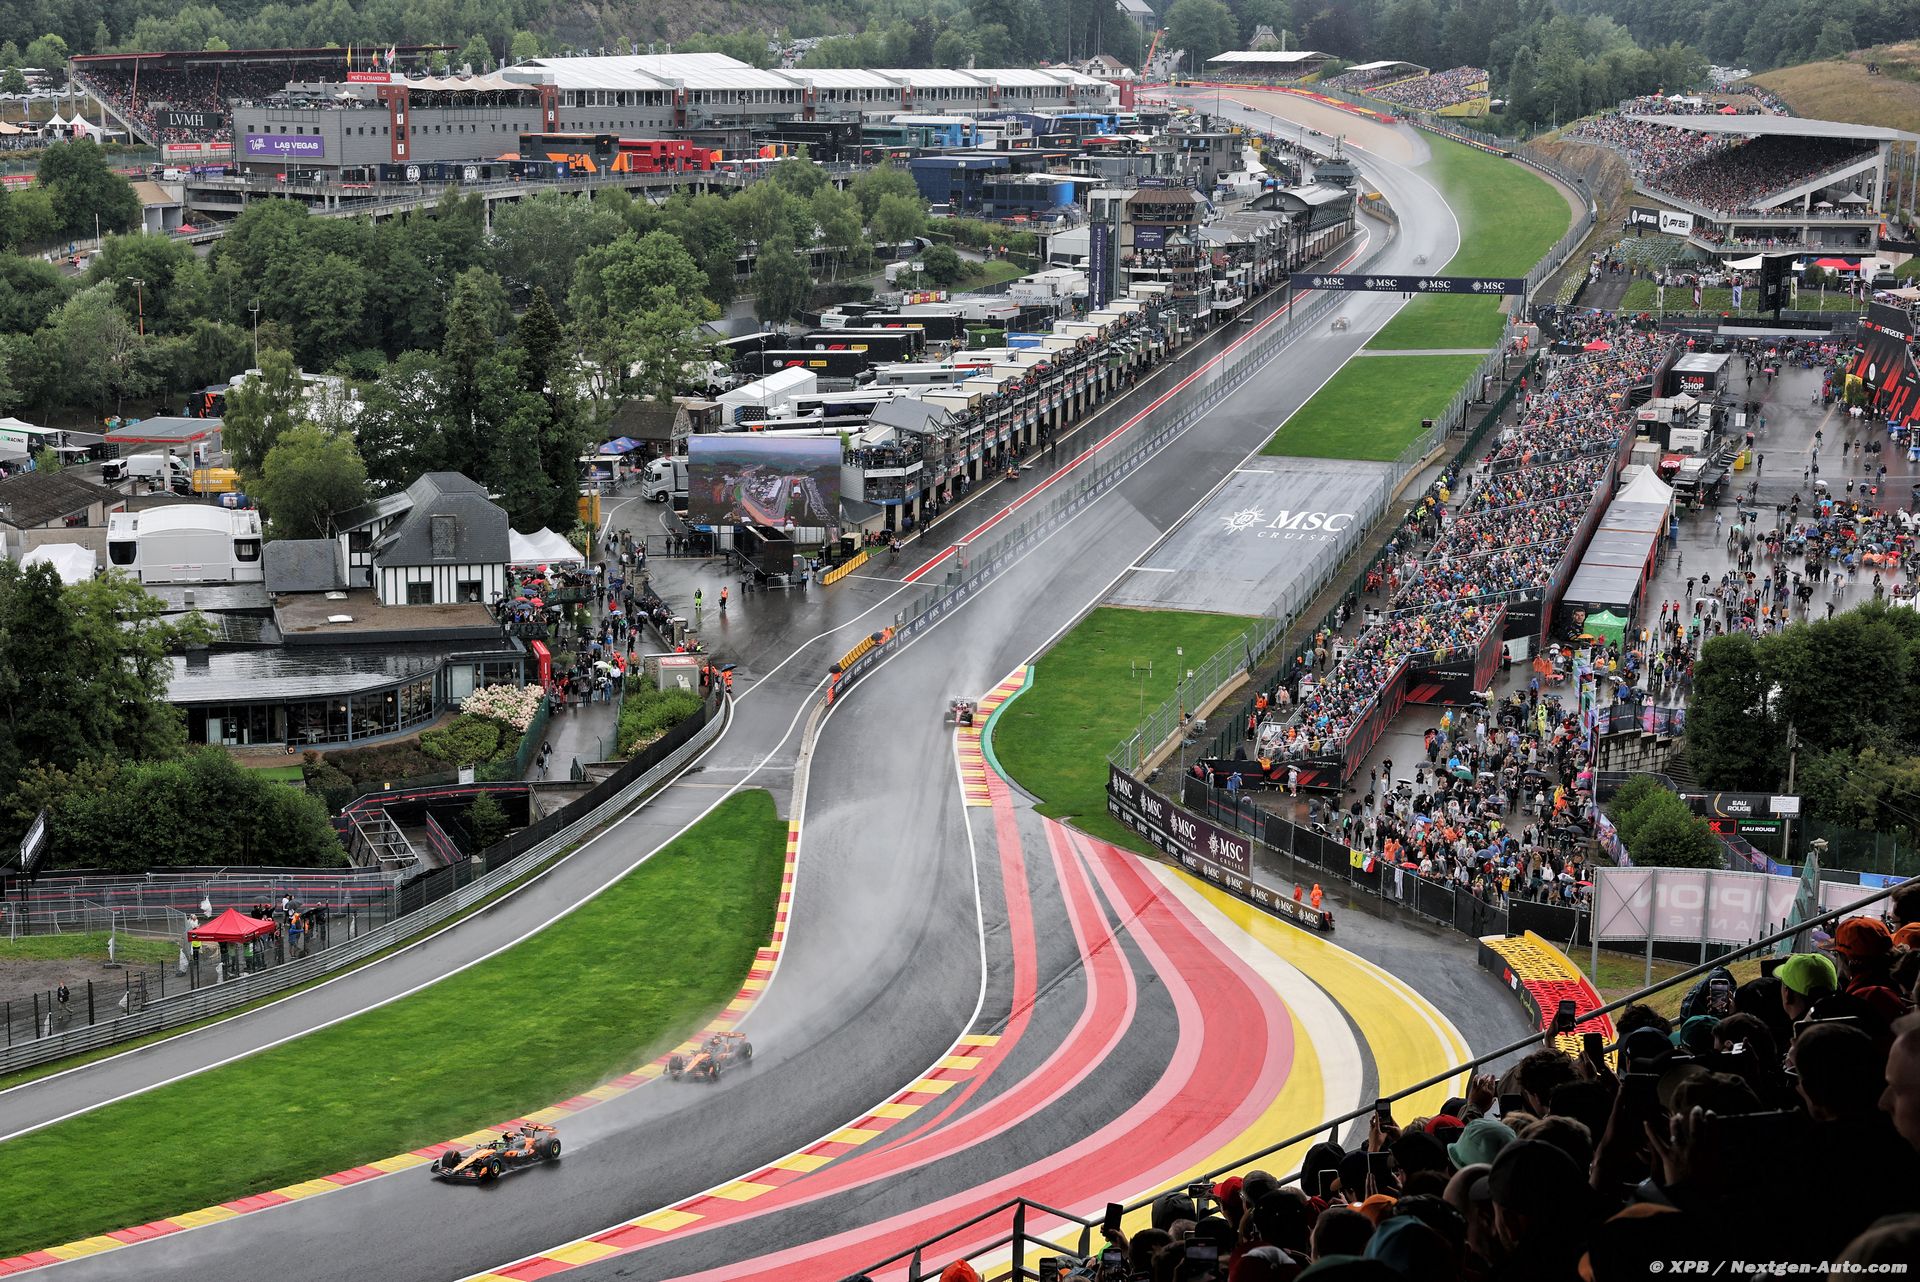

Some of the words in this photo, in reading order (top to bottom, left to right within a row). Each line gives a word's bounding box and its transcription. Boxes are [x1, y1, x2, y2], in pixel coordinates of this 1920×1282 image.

[169, 113, 204, 126] LVMH
[274, 142, 290, 150] LAS
[291, 142, 318, 150] VEGAS
[1323, 277, 1344, 286] MSC
[1376, 278, 1398, 287] MSC
[1428, 280, 1450, 289] MSC
[1483, 282, 1504, 290] MSC
[1881, 326, 1904, 340] FANZONE
[1265, 510, 1354, 532] MSC
[1119, 777, 1132, 798] MSC
[1147, 796, 1162, 819] MSC
[1178, 816, 1196, 840] MSC
[1220, 838, 1243, 862] MSC
[1186, 855, 1196, 866] MSC
[1208, 866, 1219, 878] MSC
[1231, 877, 1243, 889] MSC
[1256, 889, 1268, 902] MSC
[1281, 900, 1294, 913] MSC
[1305, 911, 1318, 924] MSC
